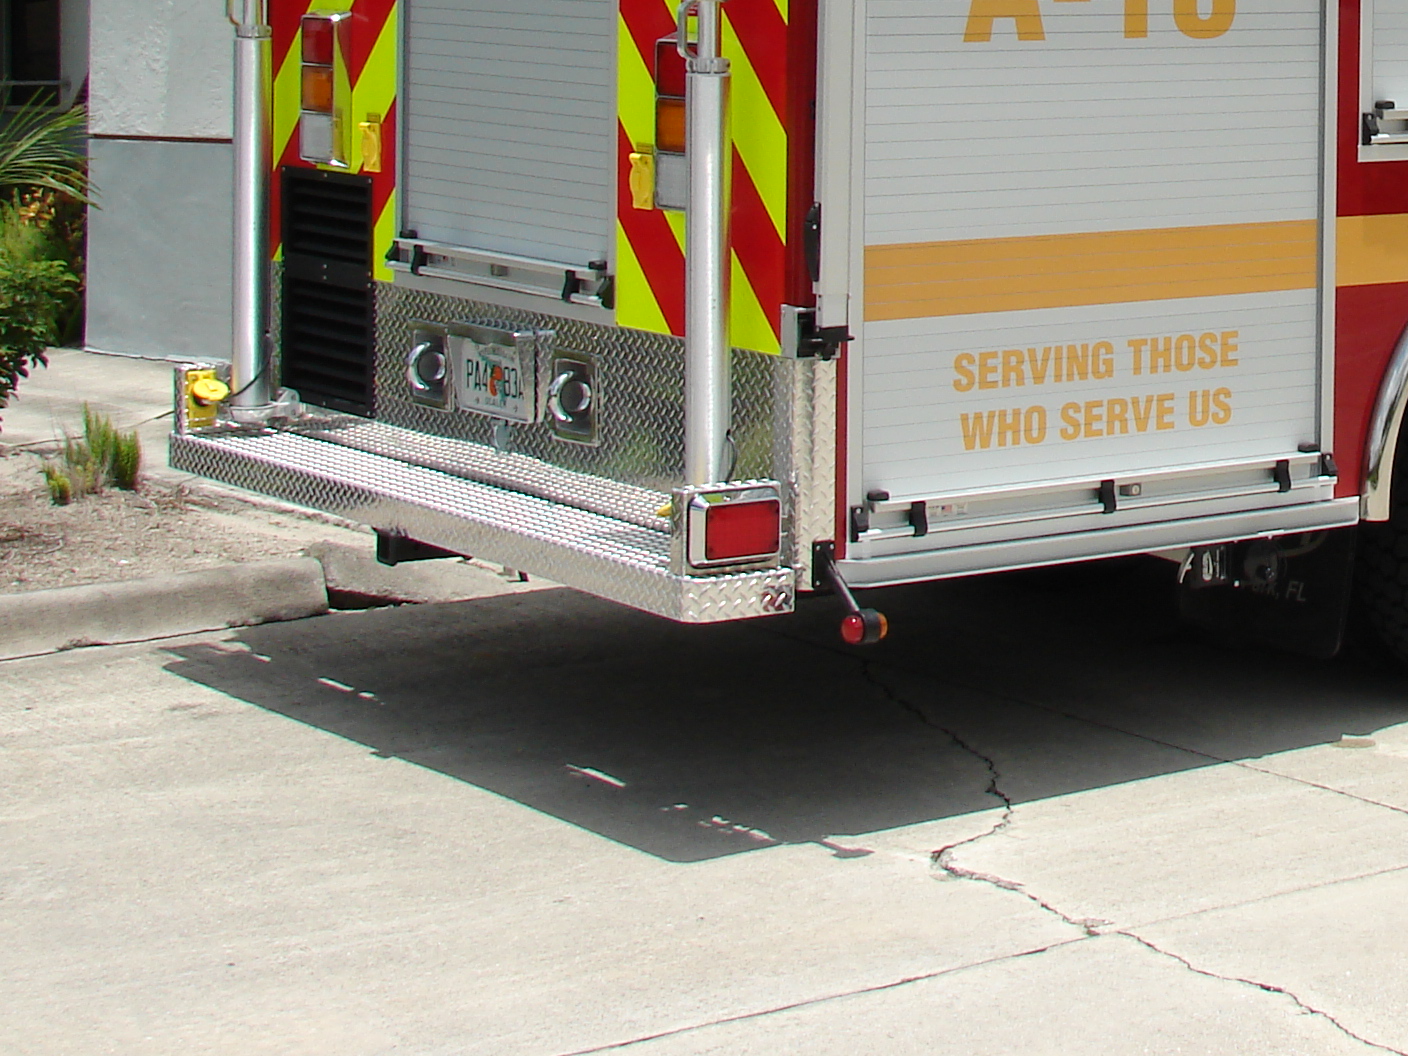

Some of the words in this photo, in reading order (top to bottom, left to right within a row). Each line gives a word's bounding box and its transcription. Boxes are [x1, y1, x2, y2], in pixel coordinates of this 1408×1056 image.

[952, 341, 1115, 393] SERVING
[1127, 330, 1239, 376] THOSE
[960, 405, 1047, 451] WHO
[1059, 392, 1175, 442] SERVE
[1188, 387, 1233, 427] US
